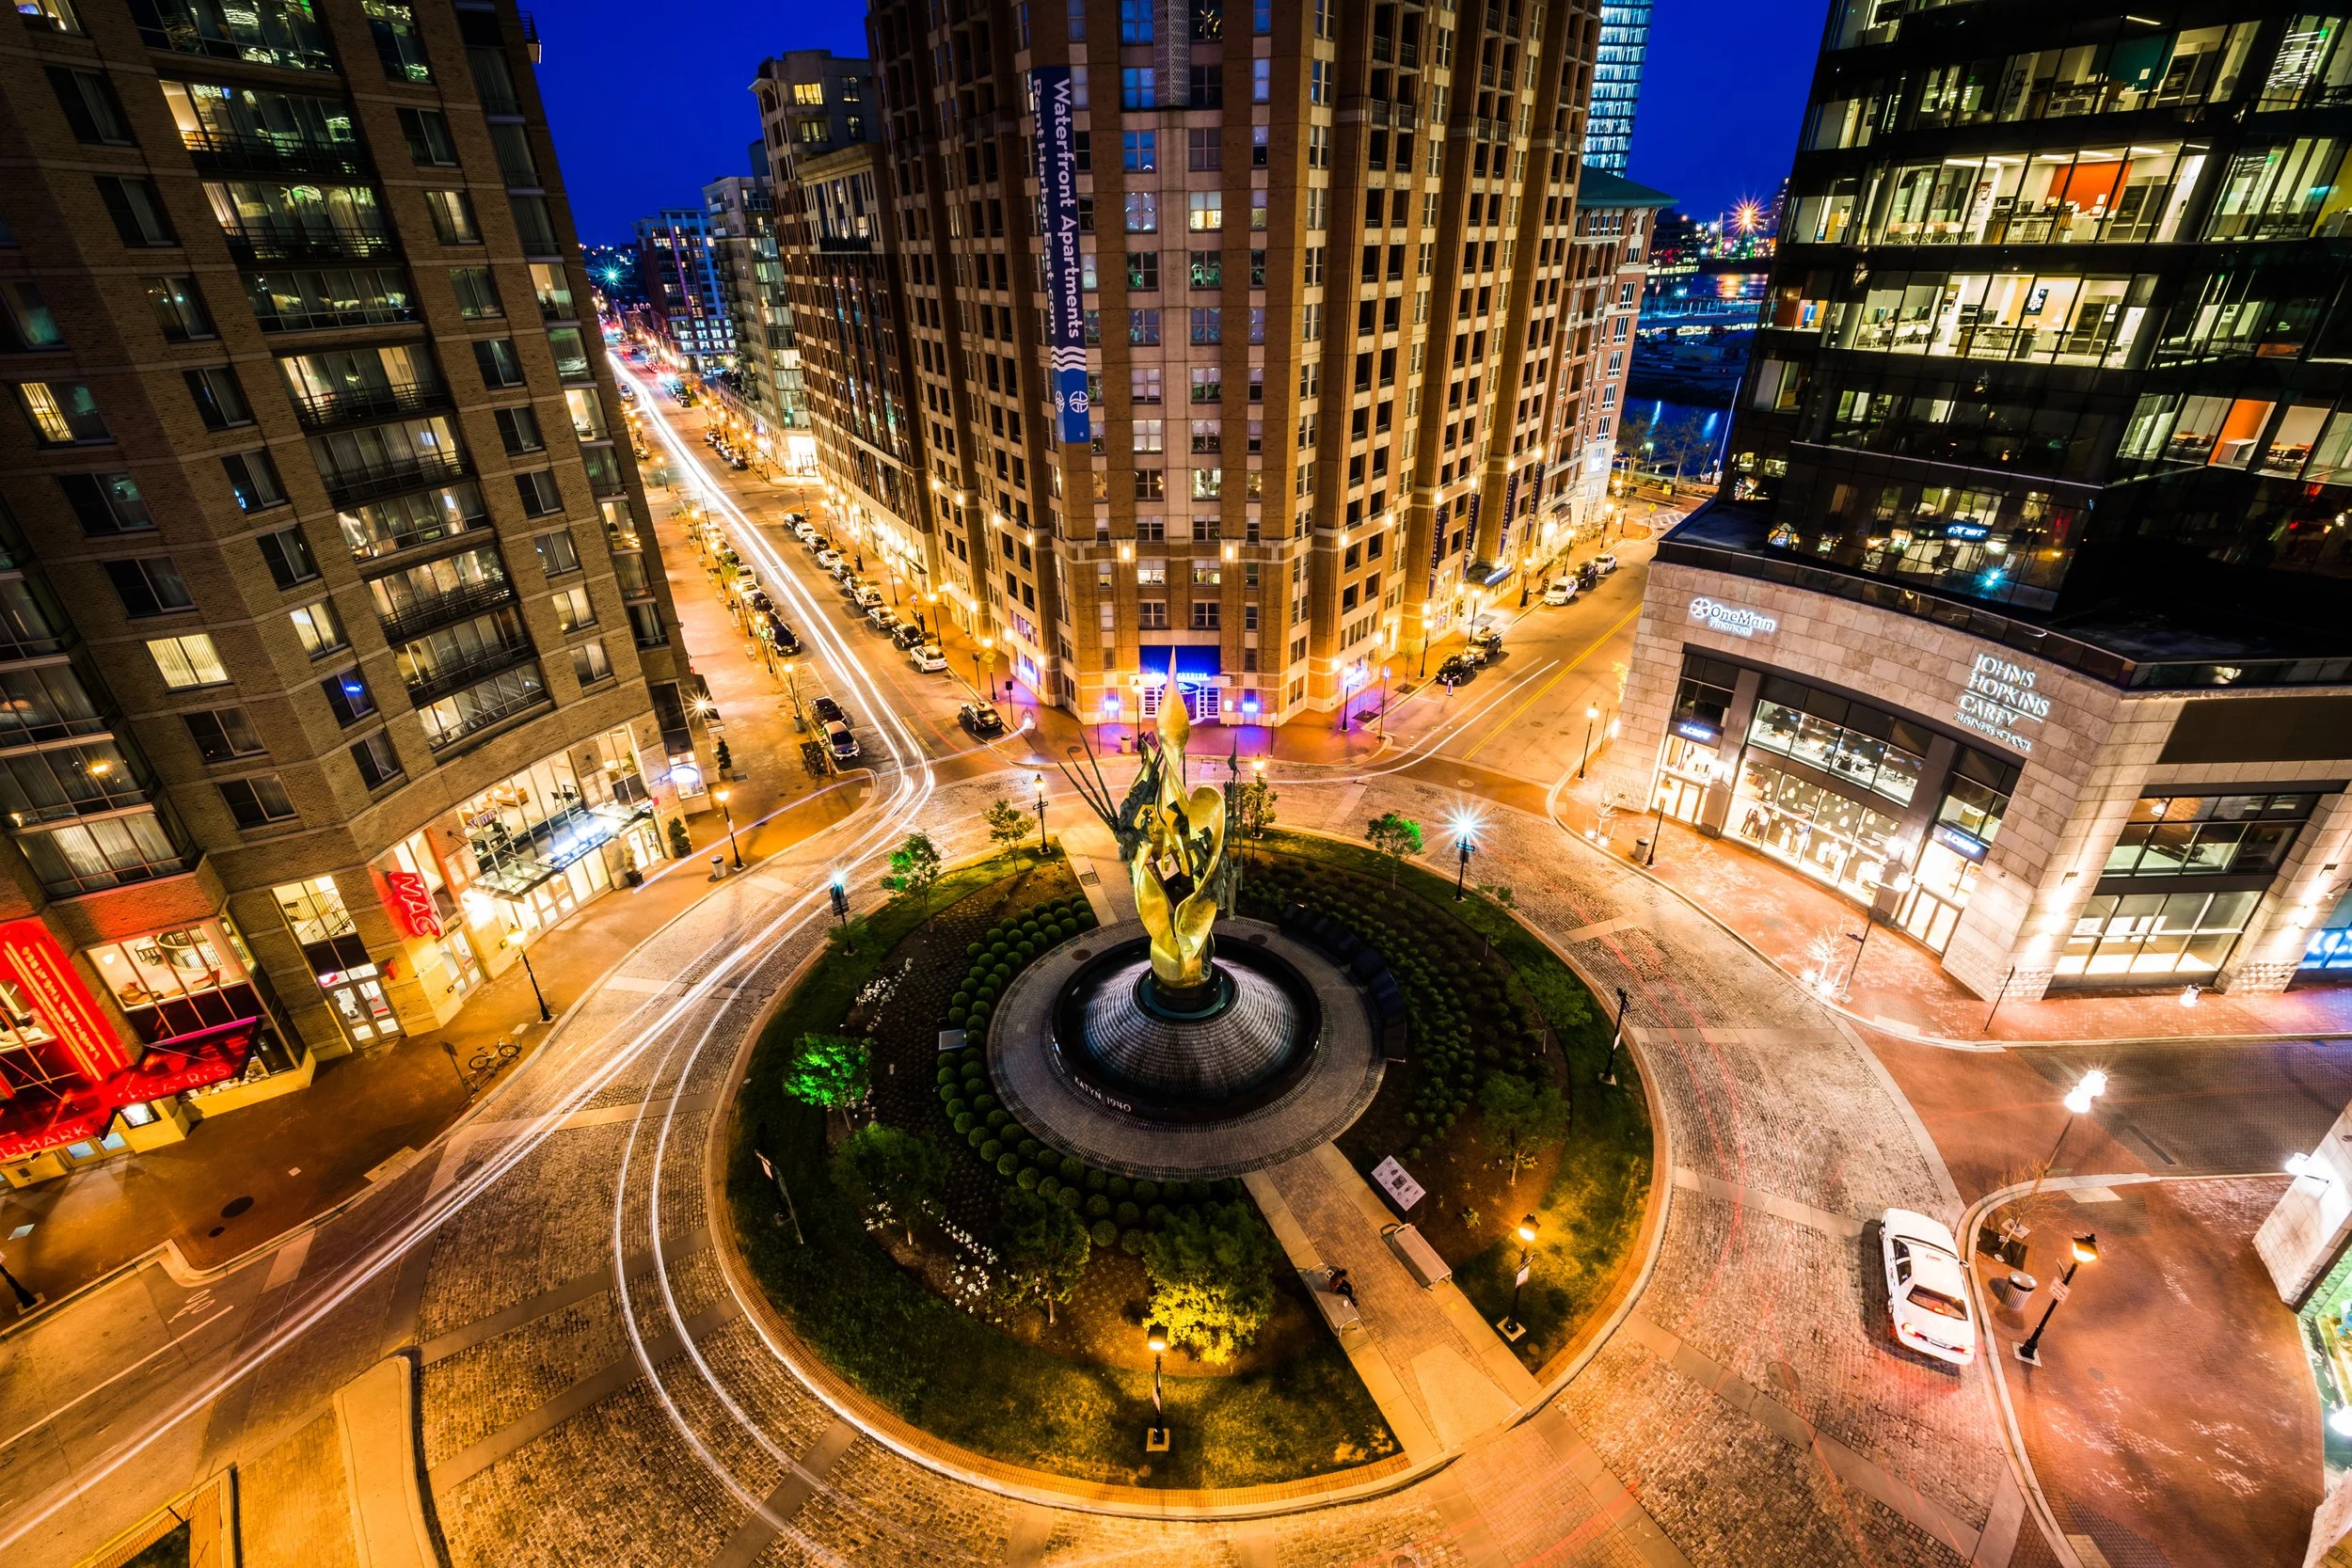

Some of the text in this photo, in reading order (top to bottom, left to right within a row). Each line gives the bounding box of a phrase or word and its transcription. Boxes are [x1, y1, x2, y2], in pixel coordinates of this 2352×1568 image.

[1054, 78, 1083, 339] Waterfront Apartments
[1710, 606, 1773, 630] OneMain
[1974, 654, 2036, 689] JOHNS
[1959, 695, 2019, 727] CAREY
[1967, 672, 2050, 717] HOPKINS
[401, 877, 437, 935] MAC
[1106, 1097, 1132, 1112] 1940
